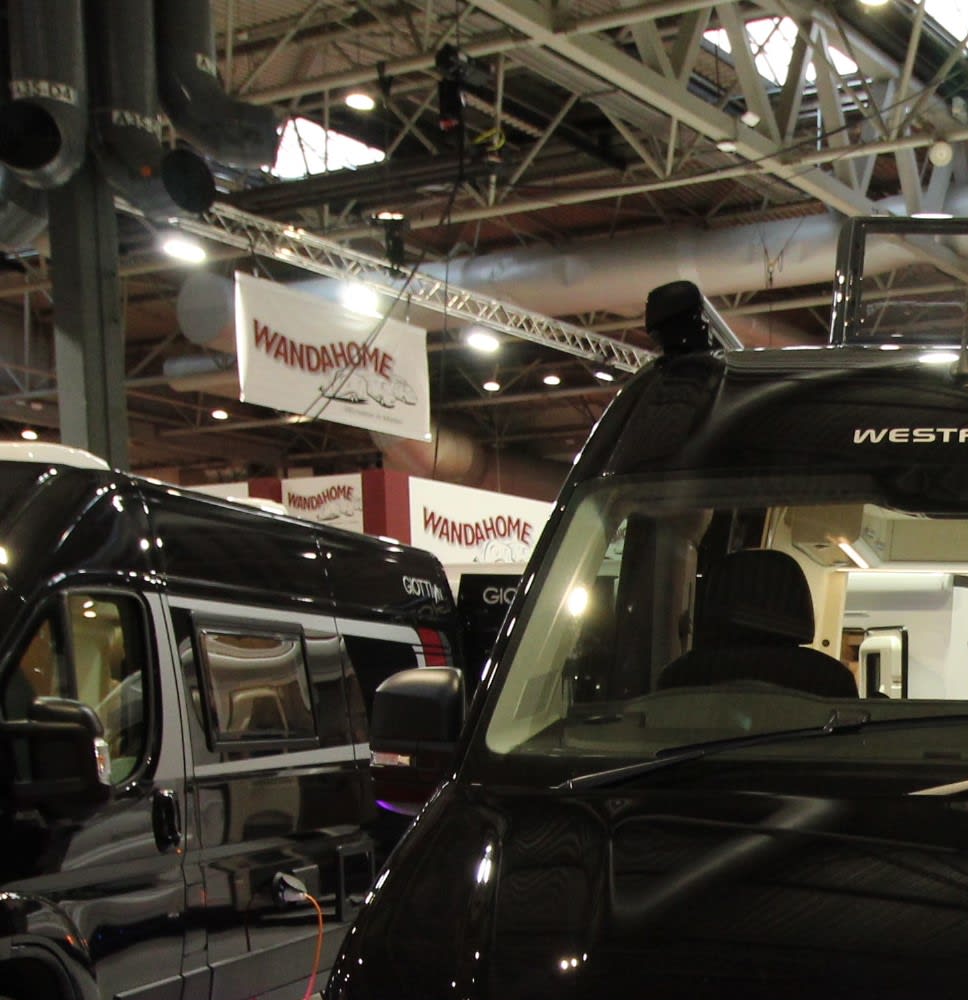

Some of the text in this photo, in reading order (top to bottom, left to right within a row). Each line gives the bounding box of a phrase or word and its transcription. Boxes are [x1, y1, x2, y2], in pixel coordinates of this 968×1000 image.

[253, 318, 393, 379] WANDAHOME
[287, 485, 355, 511] WANDAHOME
[423, 506, 534, 546] WANDAHOME
